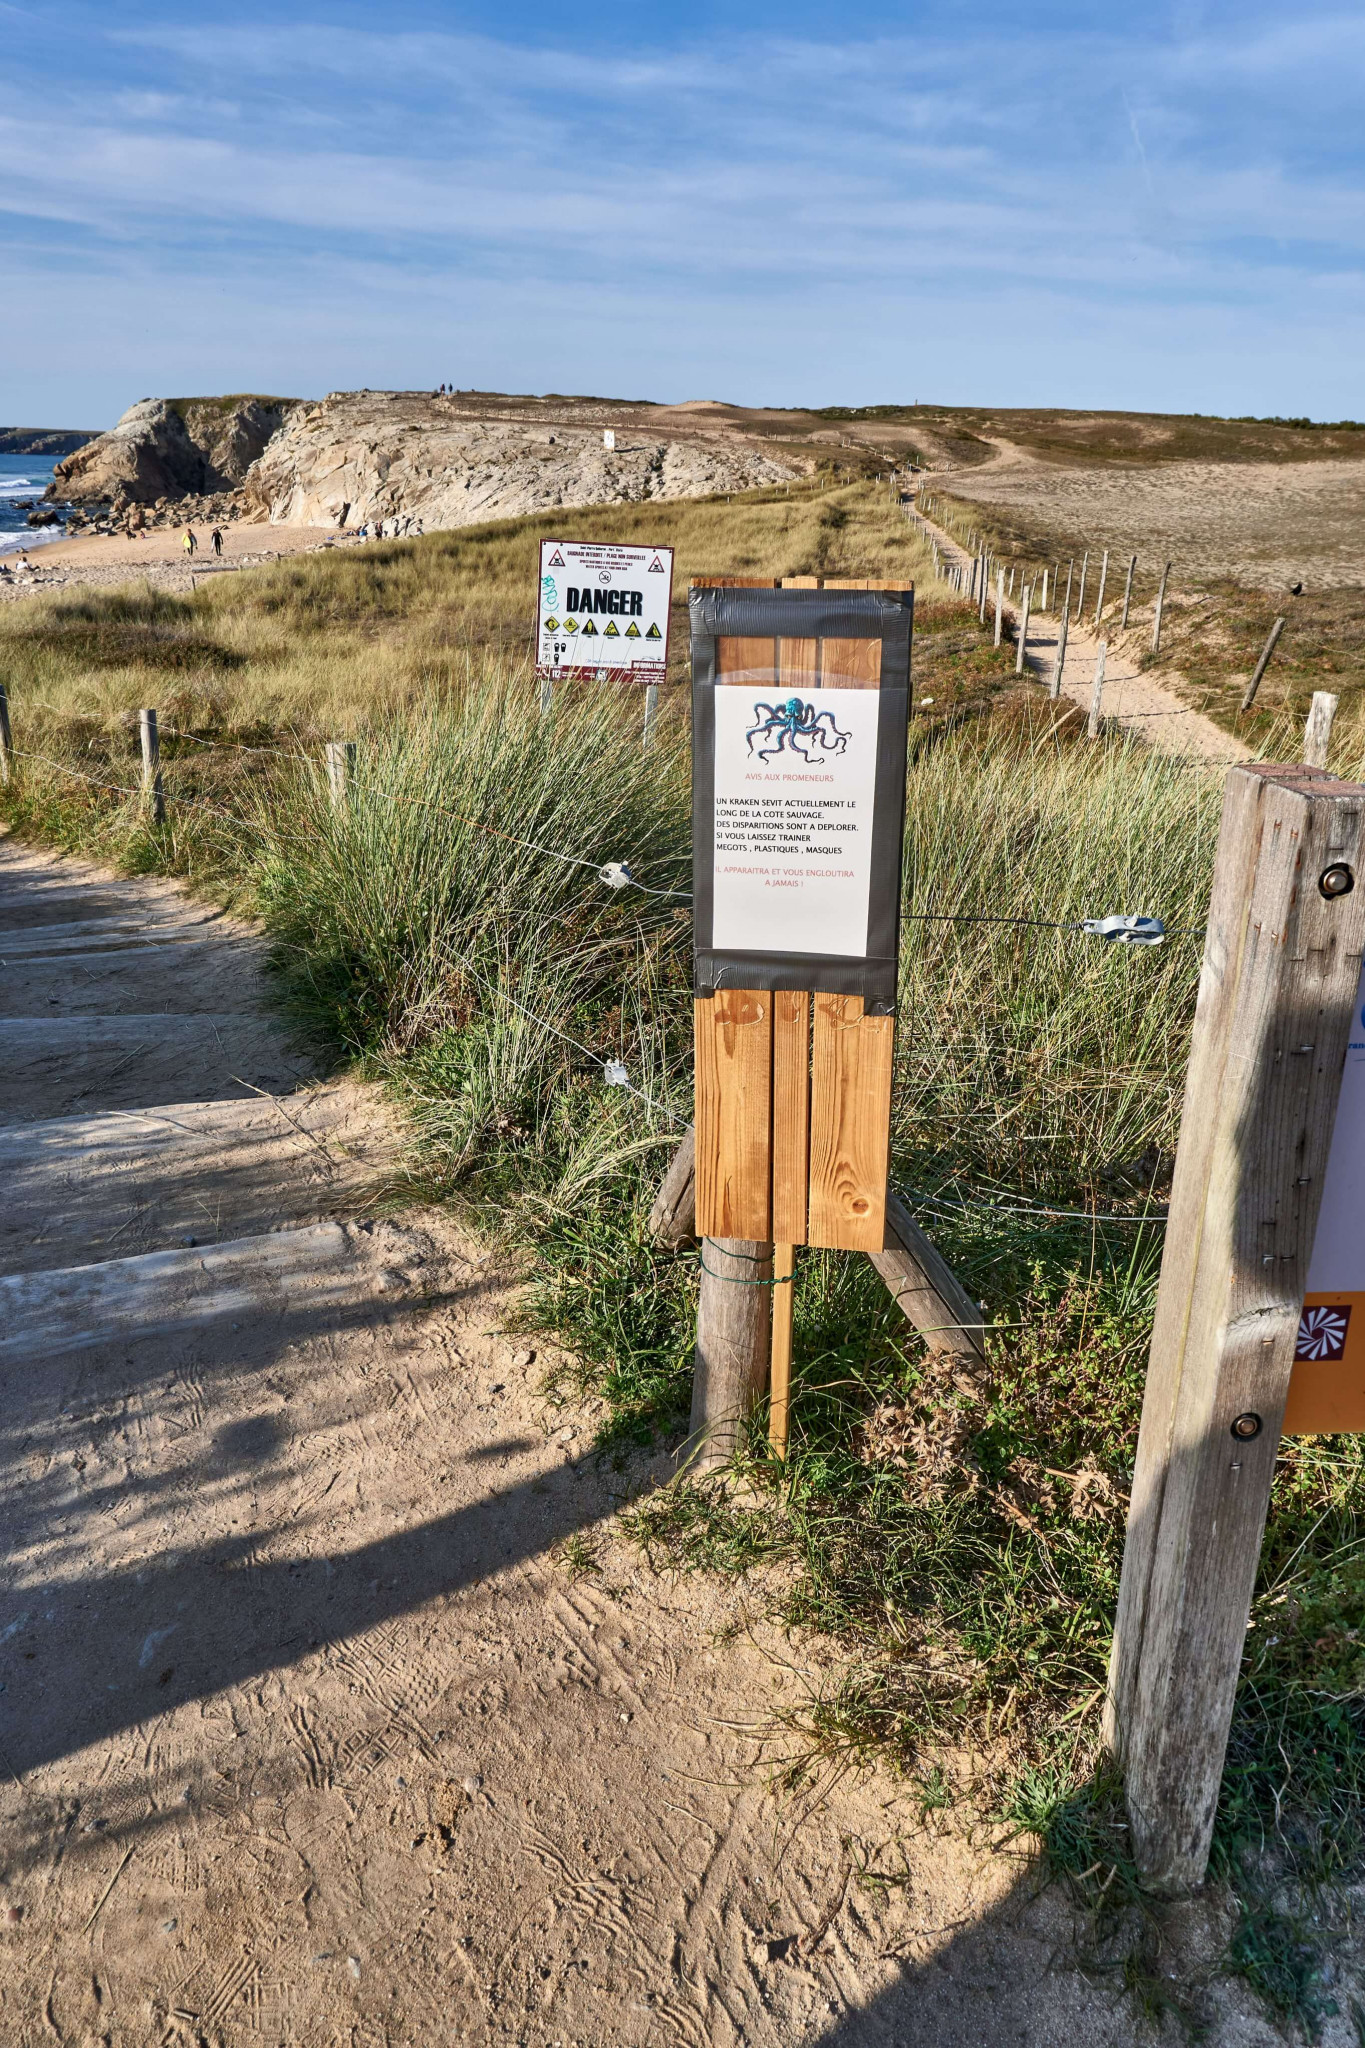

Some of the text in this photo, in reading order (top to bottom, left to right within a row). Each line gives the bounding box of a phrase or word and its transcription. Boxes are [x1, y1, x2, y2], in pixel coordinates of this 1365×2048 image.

[566, 587, 643, 616] DANGER
[782, 774, 834, 782] PROMENEURS
[723, 867, 769, 875] APPARAITRA
